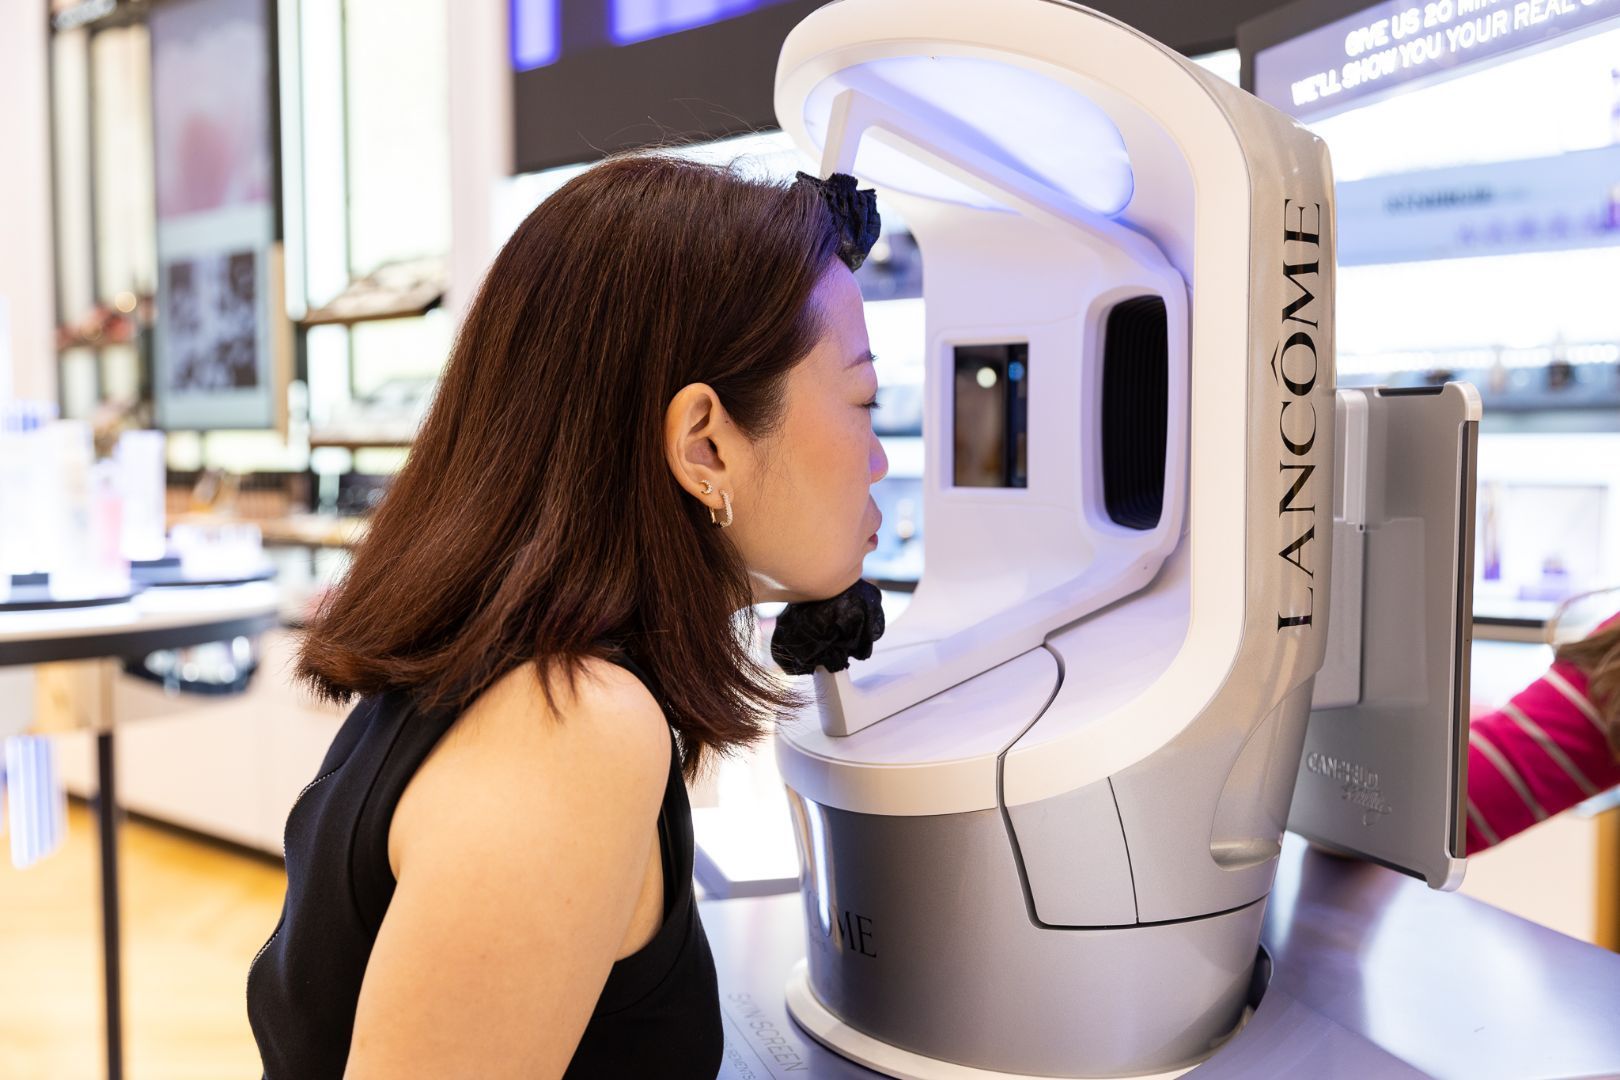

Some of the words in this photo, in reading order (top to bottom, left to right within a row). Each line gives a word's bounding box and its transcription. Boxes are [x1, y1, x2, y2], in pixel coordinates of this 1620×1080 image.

[1342, 47, 1397, 88] SHOW
[1399, 32, 1441, 68] YOU
[1446, 9, 1508, 52] YOUR
[1514, 0, 1576, 30] REAL
[1345, 19, 1389, 56] GIVE
[1392, 8, 1420, 39] US
[1424, 0, 1452, 27] 20
[1271, 198, 1320, 633] LANCÔME
